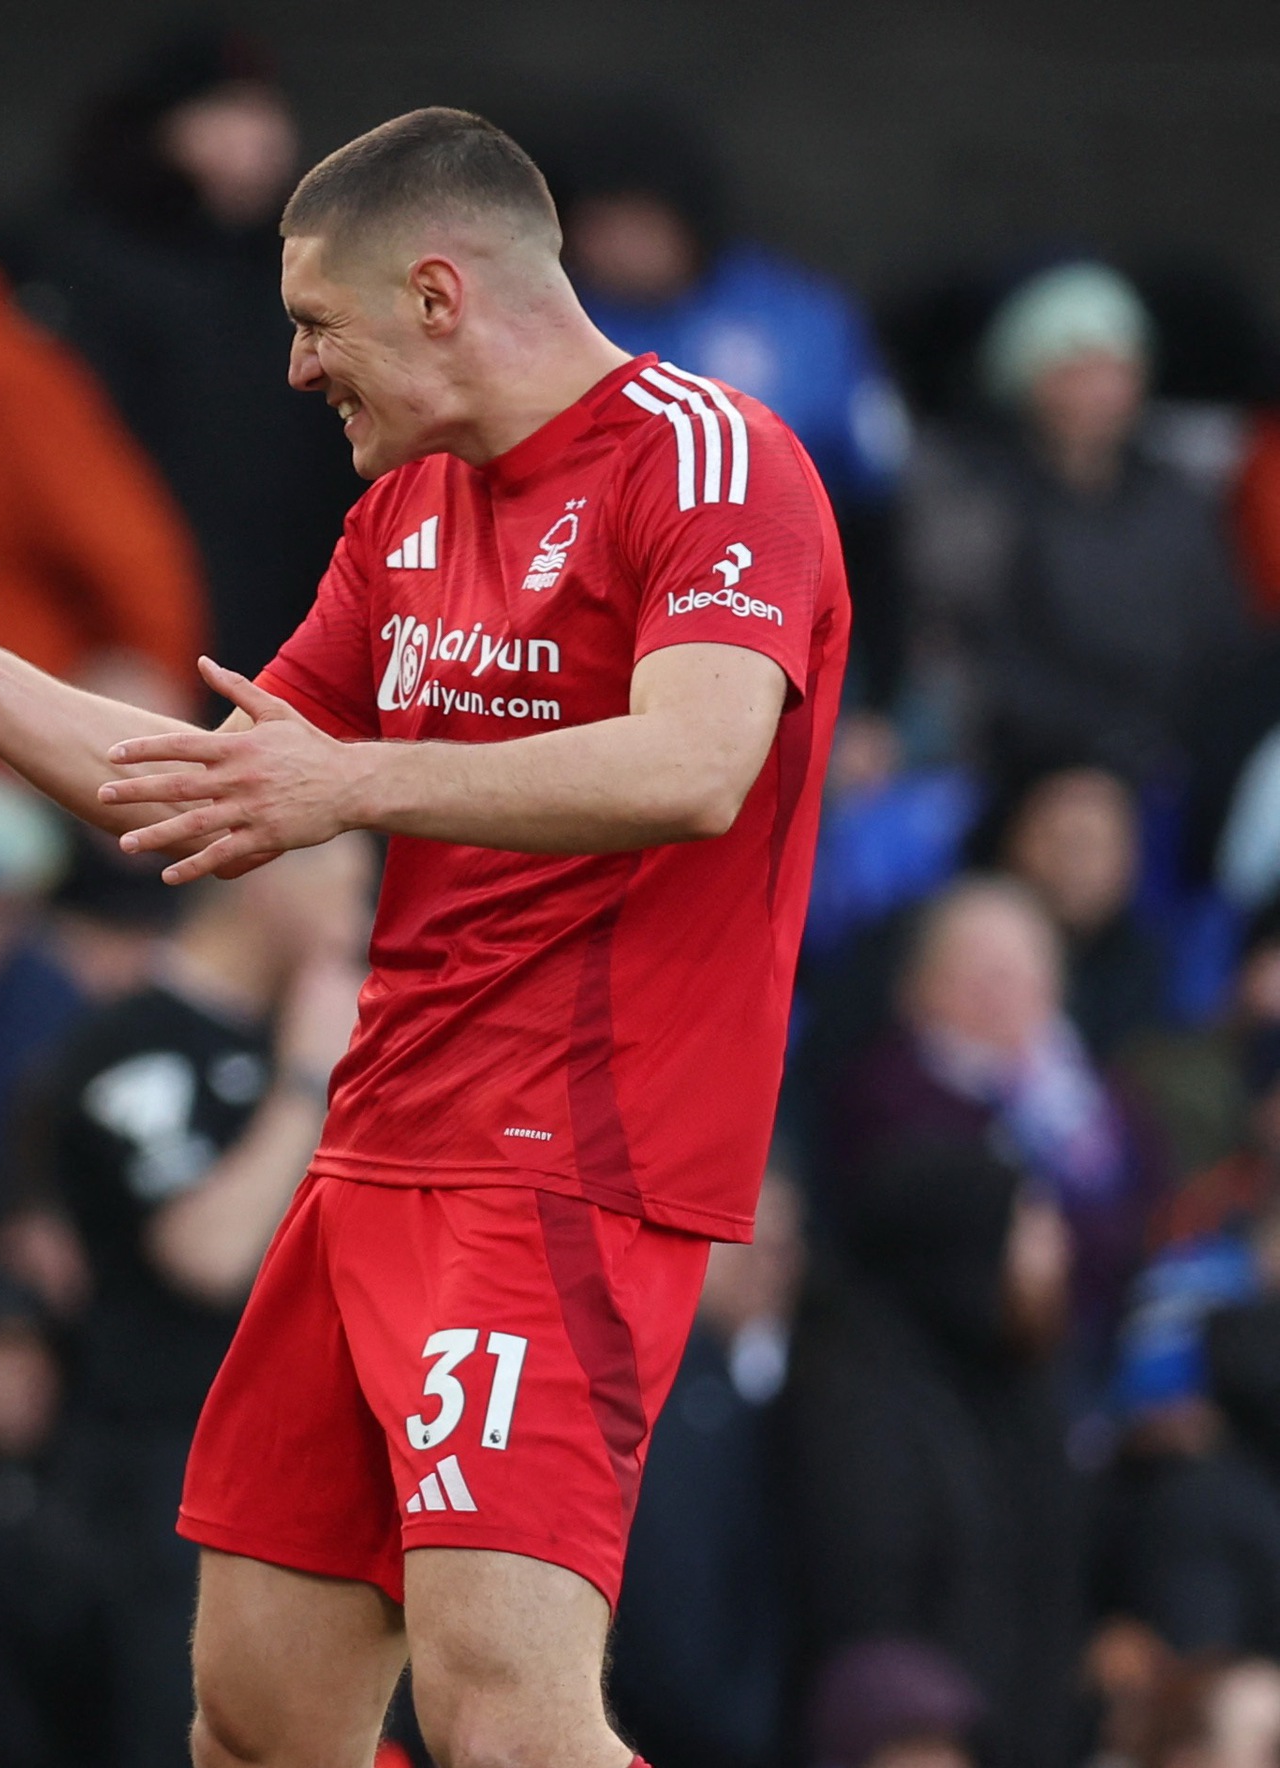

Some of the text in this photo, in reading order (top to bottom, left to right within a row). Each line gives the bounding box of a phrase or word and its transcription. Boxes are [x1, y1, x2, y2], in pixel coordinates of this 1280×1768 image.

[667, 588, 783, 627] Ideagen
[503, 1127, 552, 1141] AEROREADY
[405, 1327, 528, 1450] 31
